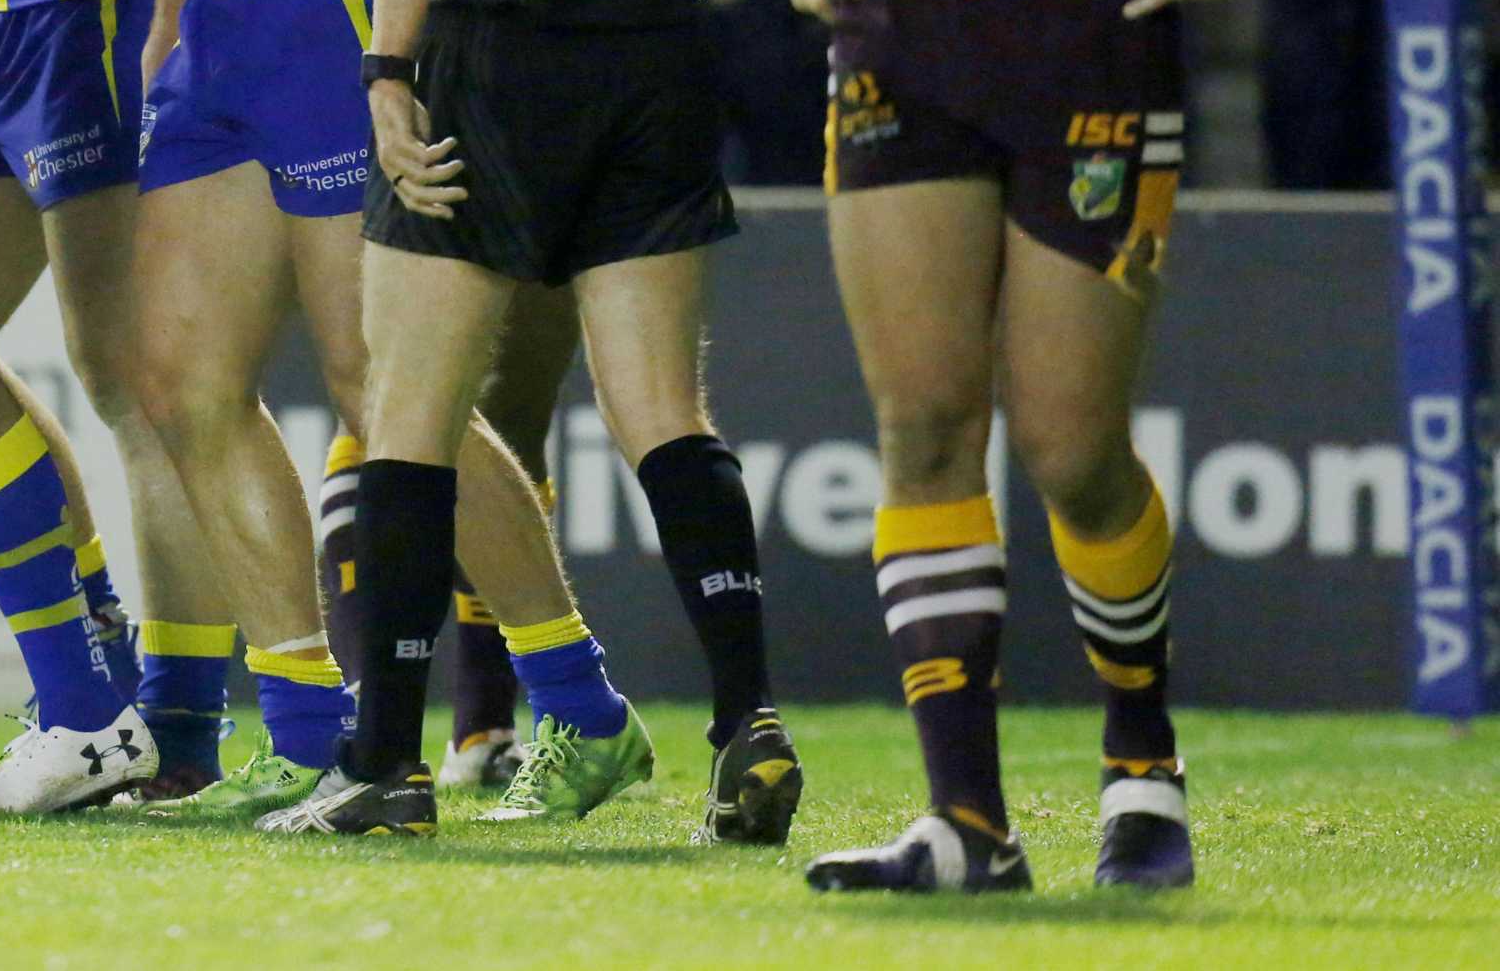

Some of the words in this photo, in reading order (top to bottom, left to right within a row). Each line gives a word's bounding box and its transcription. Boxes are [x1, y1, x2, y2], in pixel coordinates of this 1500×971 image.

[34, 131, 85, 160] University
[1065, 112, 1141, 147] ISC
[37, 143, 106, 181] Chester
[287, 150, 357, 176] University
[359, 148, 368, 159] o
[1399, 26, 1460, 314] DACIA
[295, 166, 369, 192] heste
[1411, 394, 1471, 684] DACIA
[395, 637, 439, 660] BL
